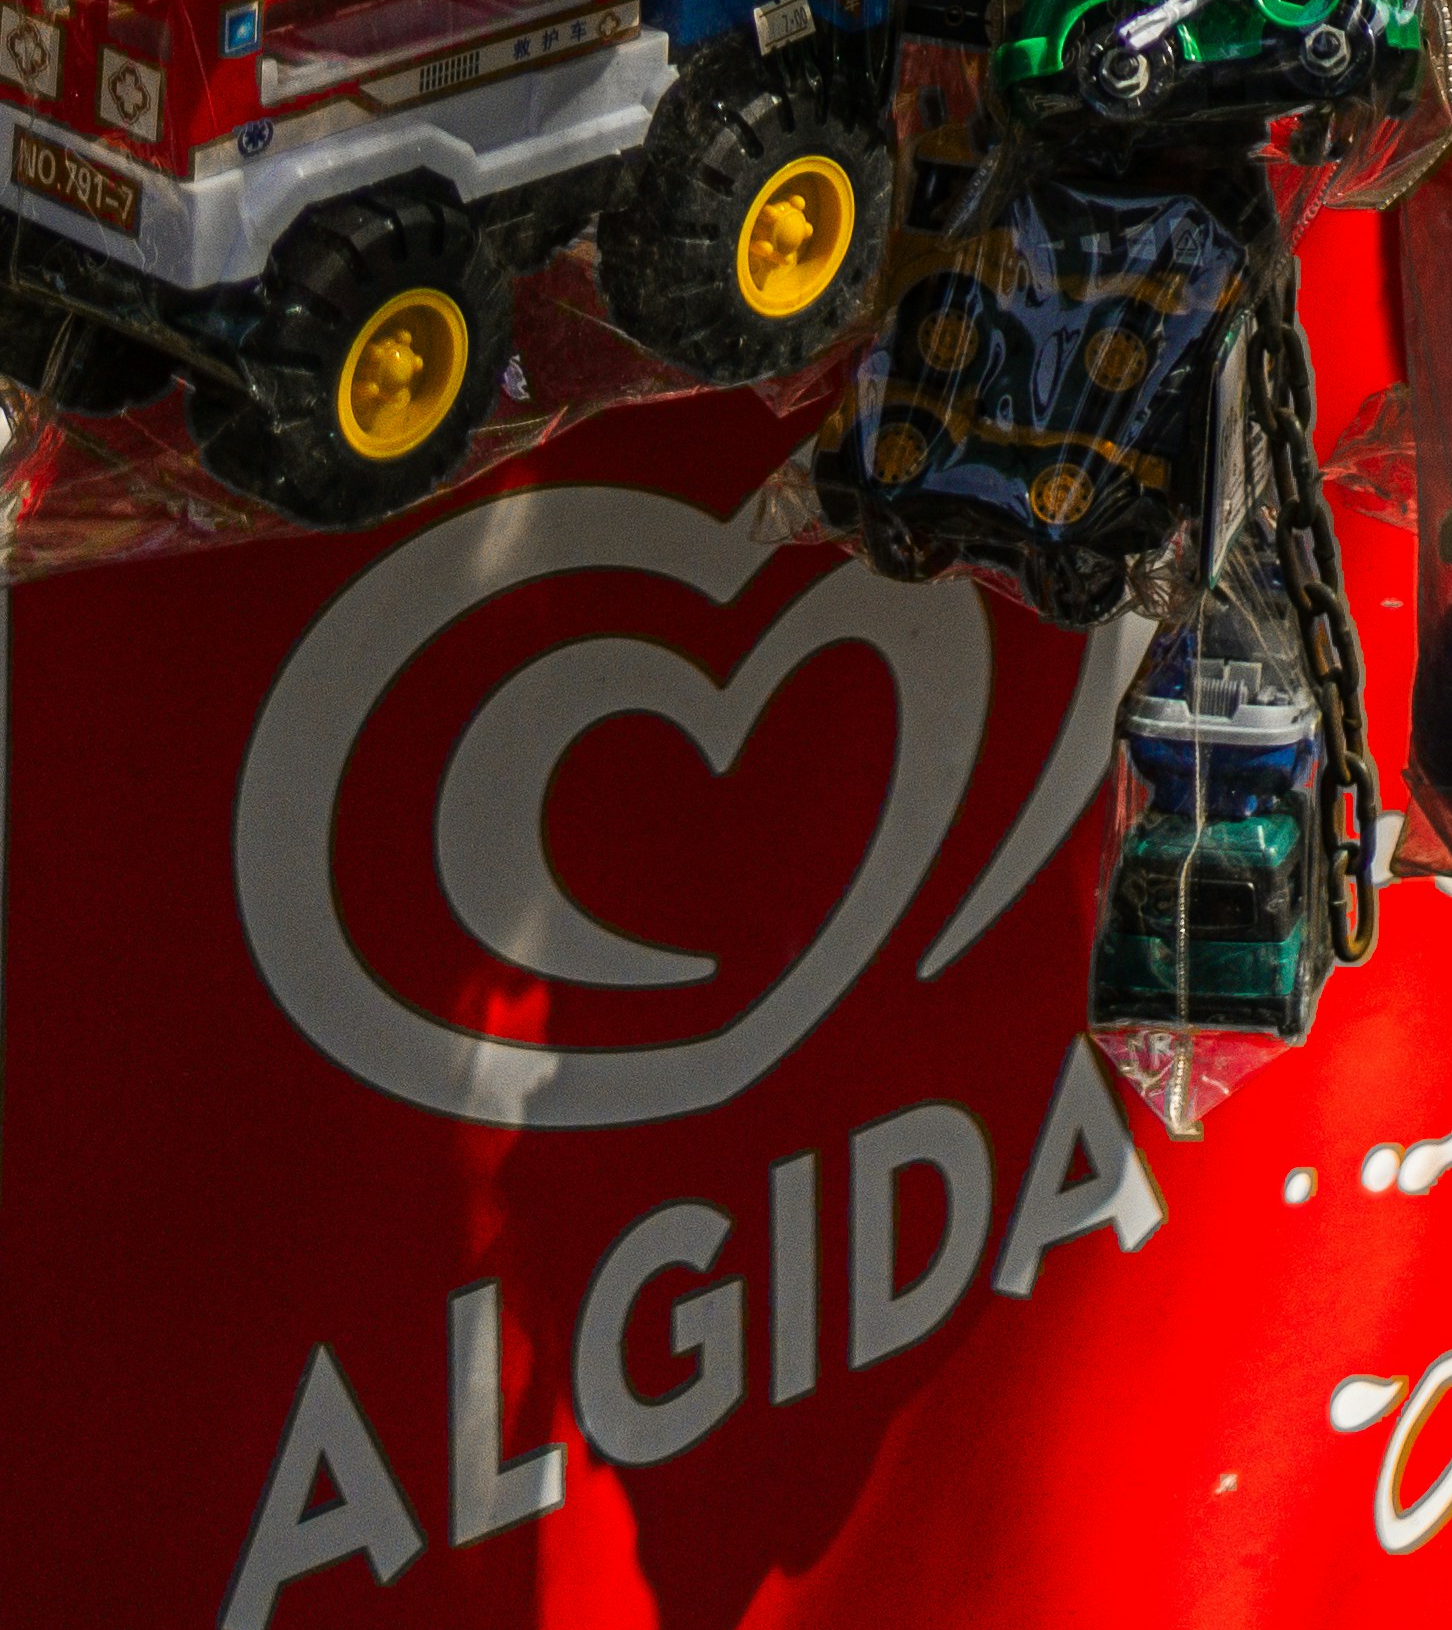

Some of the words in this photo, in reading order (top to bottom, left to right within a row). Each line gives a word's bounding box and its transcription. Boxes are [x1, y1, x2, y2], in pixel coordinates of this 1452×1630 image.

[512, 21, 588, 61] 救护车
[18, 137, 134, 220] NO.791-7
[218, 1033, 1167, 1629] ALGIDA
